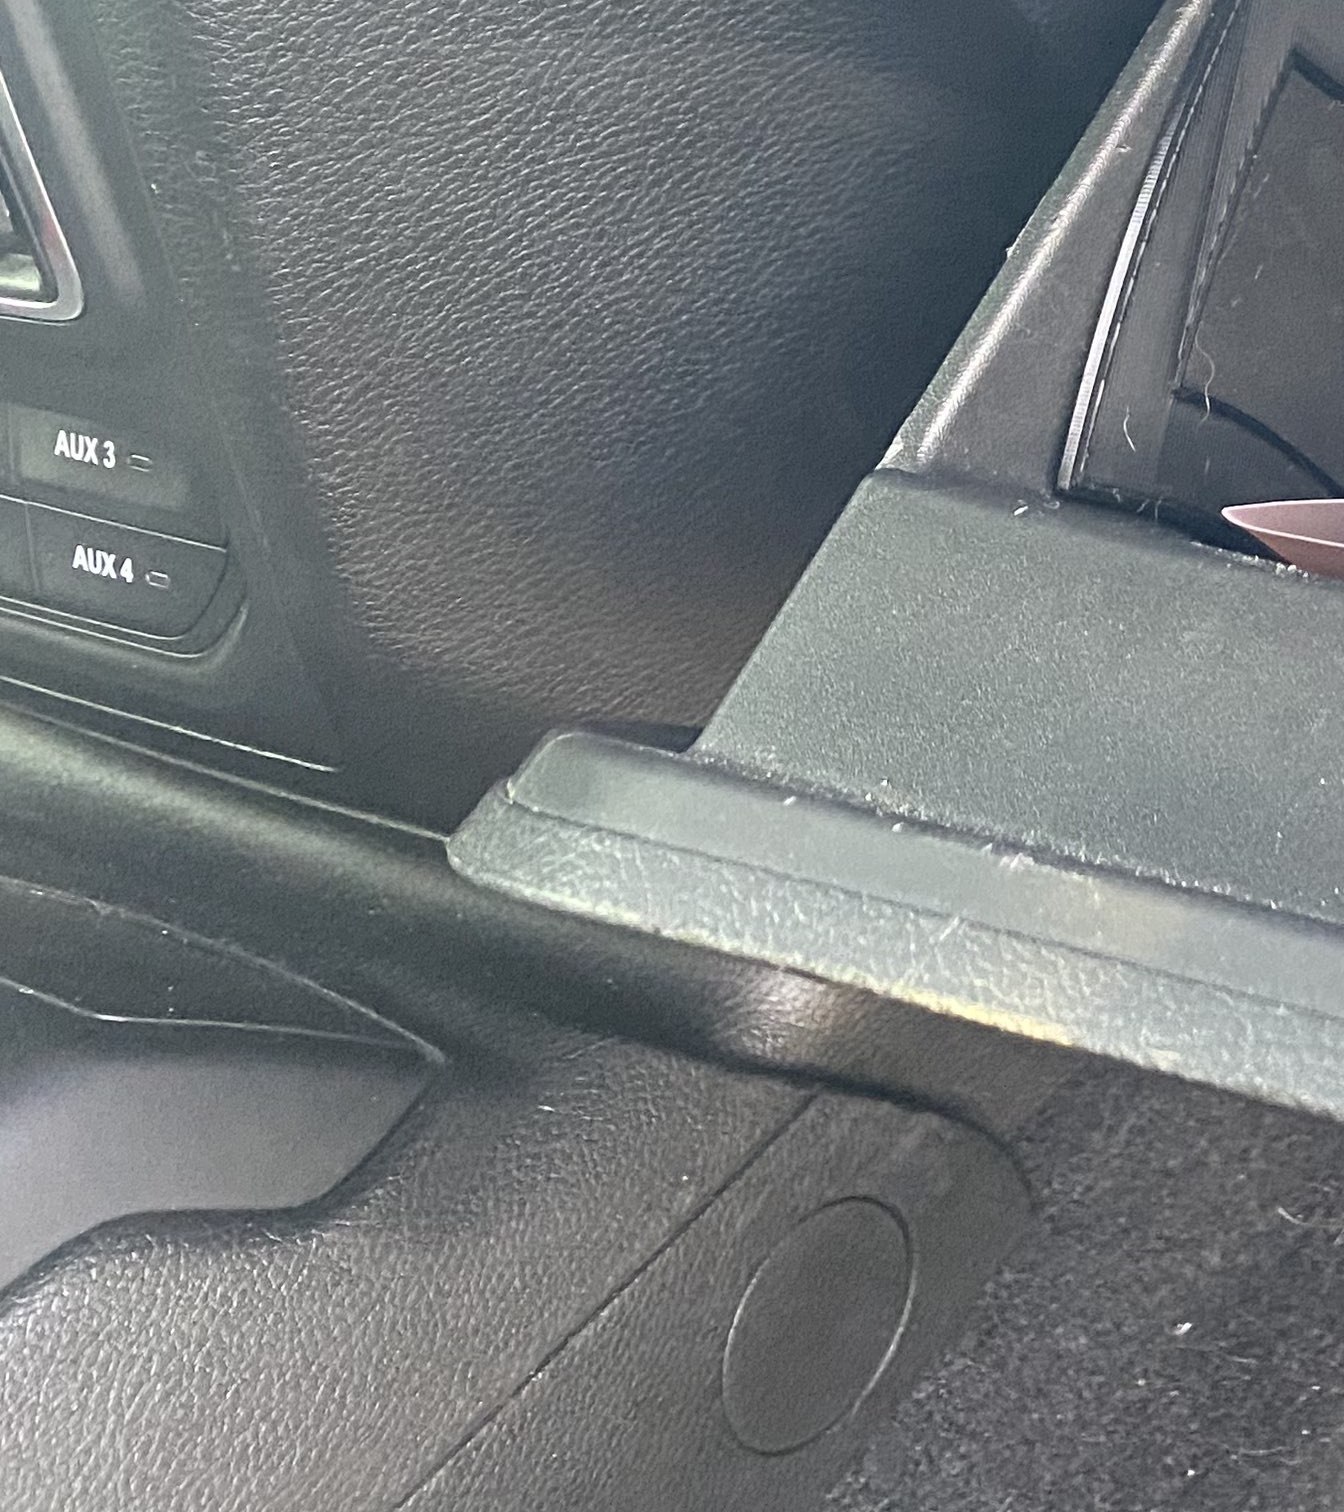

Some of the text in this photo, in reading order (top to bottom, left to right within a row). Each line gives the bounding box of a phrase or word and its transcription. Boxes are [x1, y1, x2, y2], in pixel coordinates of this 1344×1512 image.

[54, 430, 116, 469] AUX 3
[72, 545, 134, 583] AUX 4
